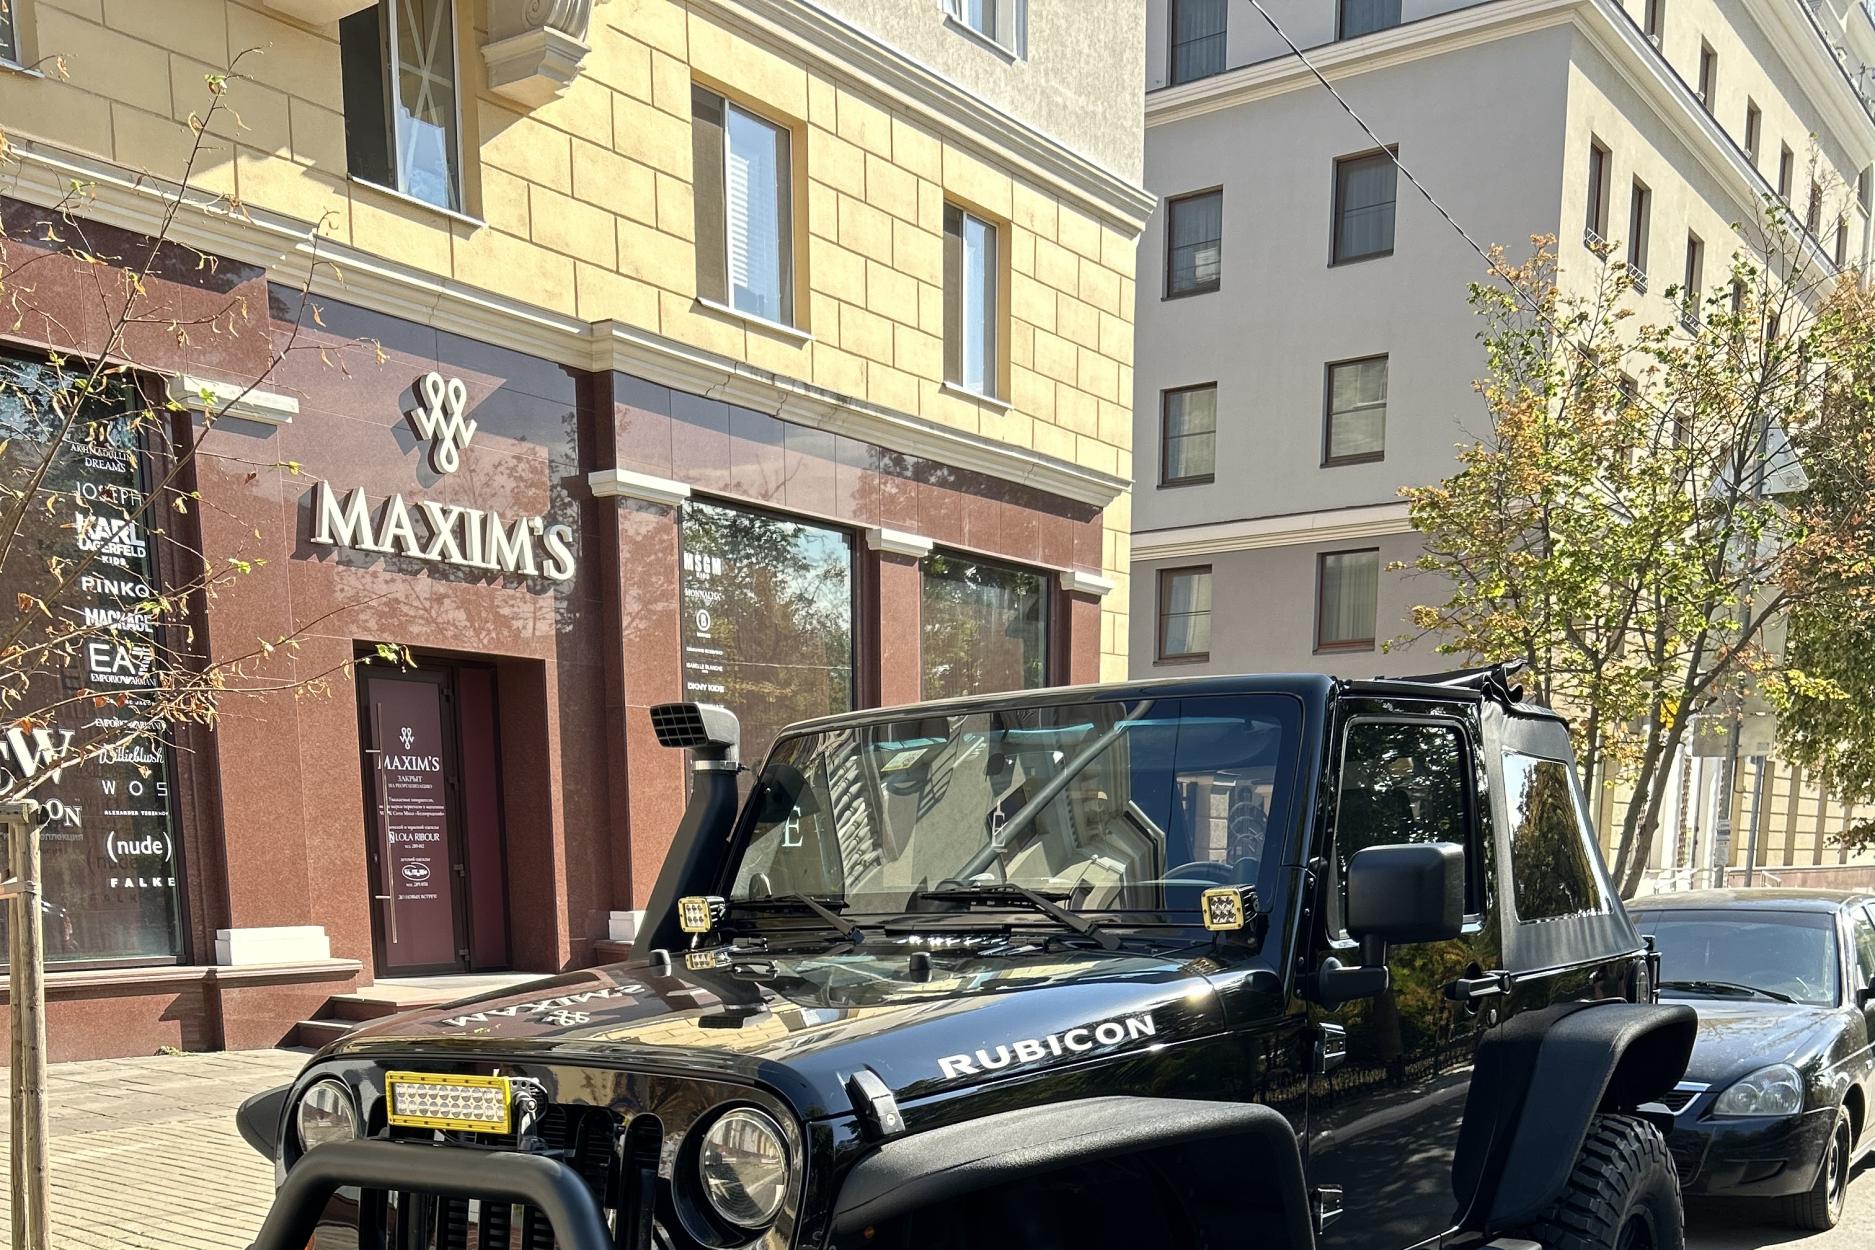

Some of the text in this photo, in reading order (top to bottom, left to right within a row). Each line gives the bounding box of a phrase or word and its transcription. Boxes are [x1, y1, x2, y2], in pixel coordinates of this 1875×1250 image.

[85, 457, 126, 473] DREAMS
[75, 511, 146, 547] KARL
[310, 480, 575, 581] MAXIM'S
[683, 551, 722, 576] MSGM
[81, 576, 151, 599] PINKO
[378, 754, 440, 772] MAXIM'S
[107, 830, 172, 863] (nude)
[110, 877, 176, 889] FALKE
[937, 1014, 1157, 1080] RUBICON
